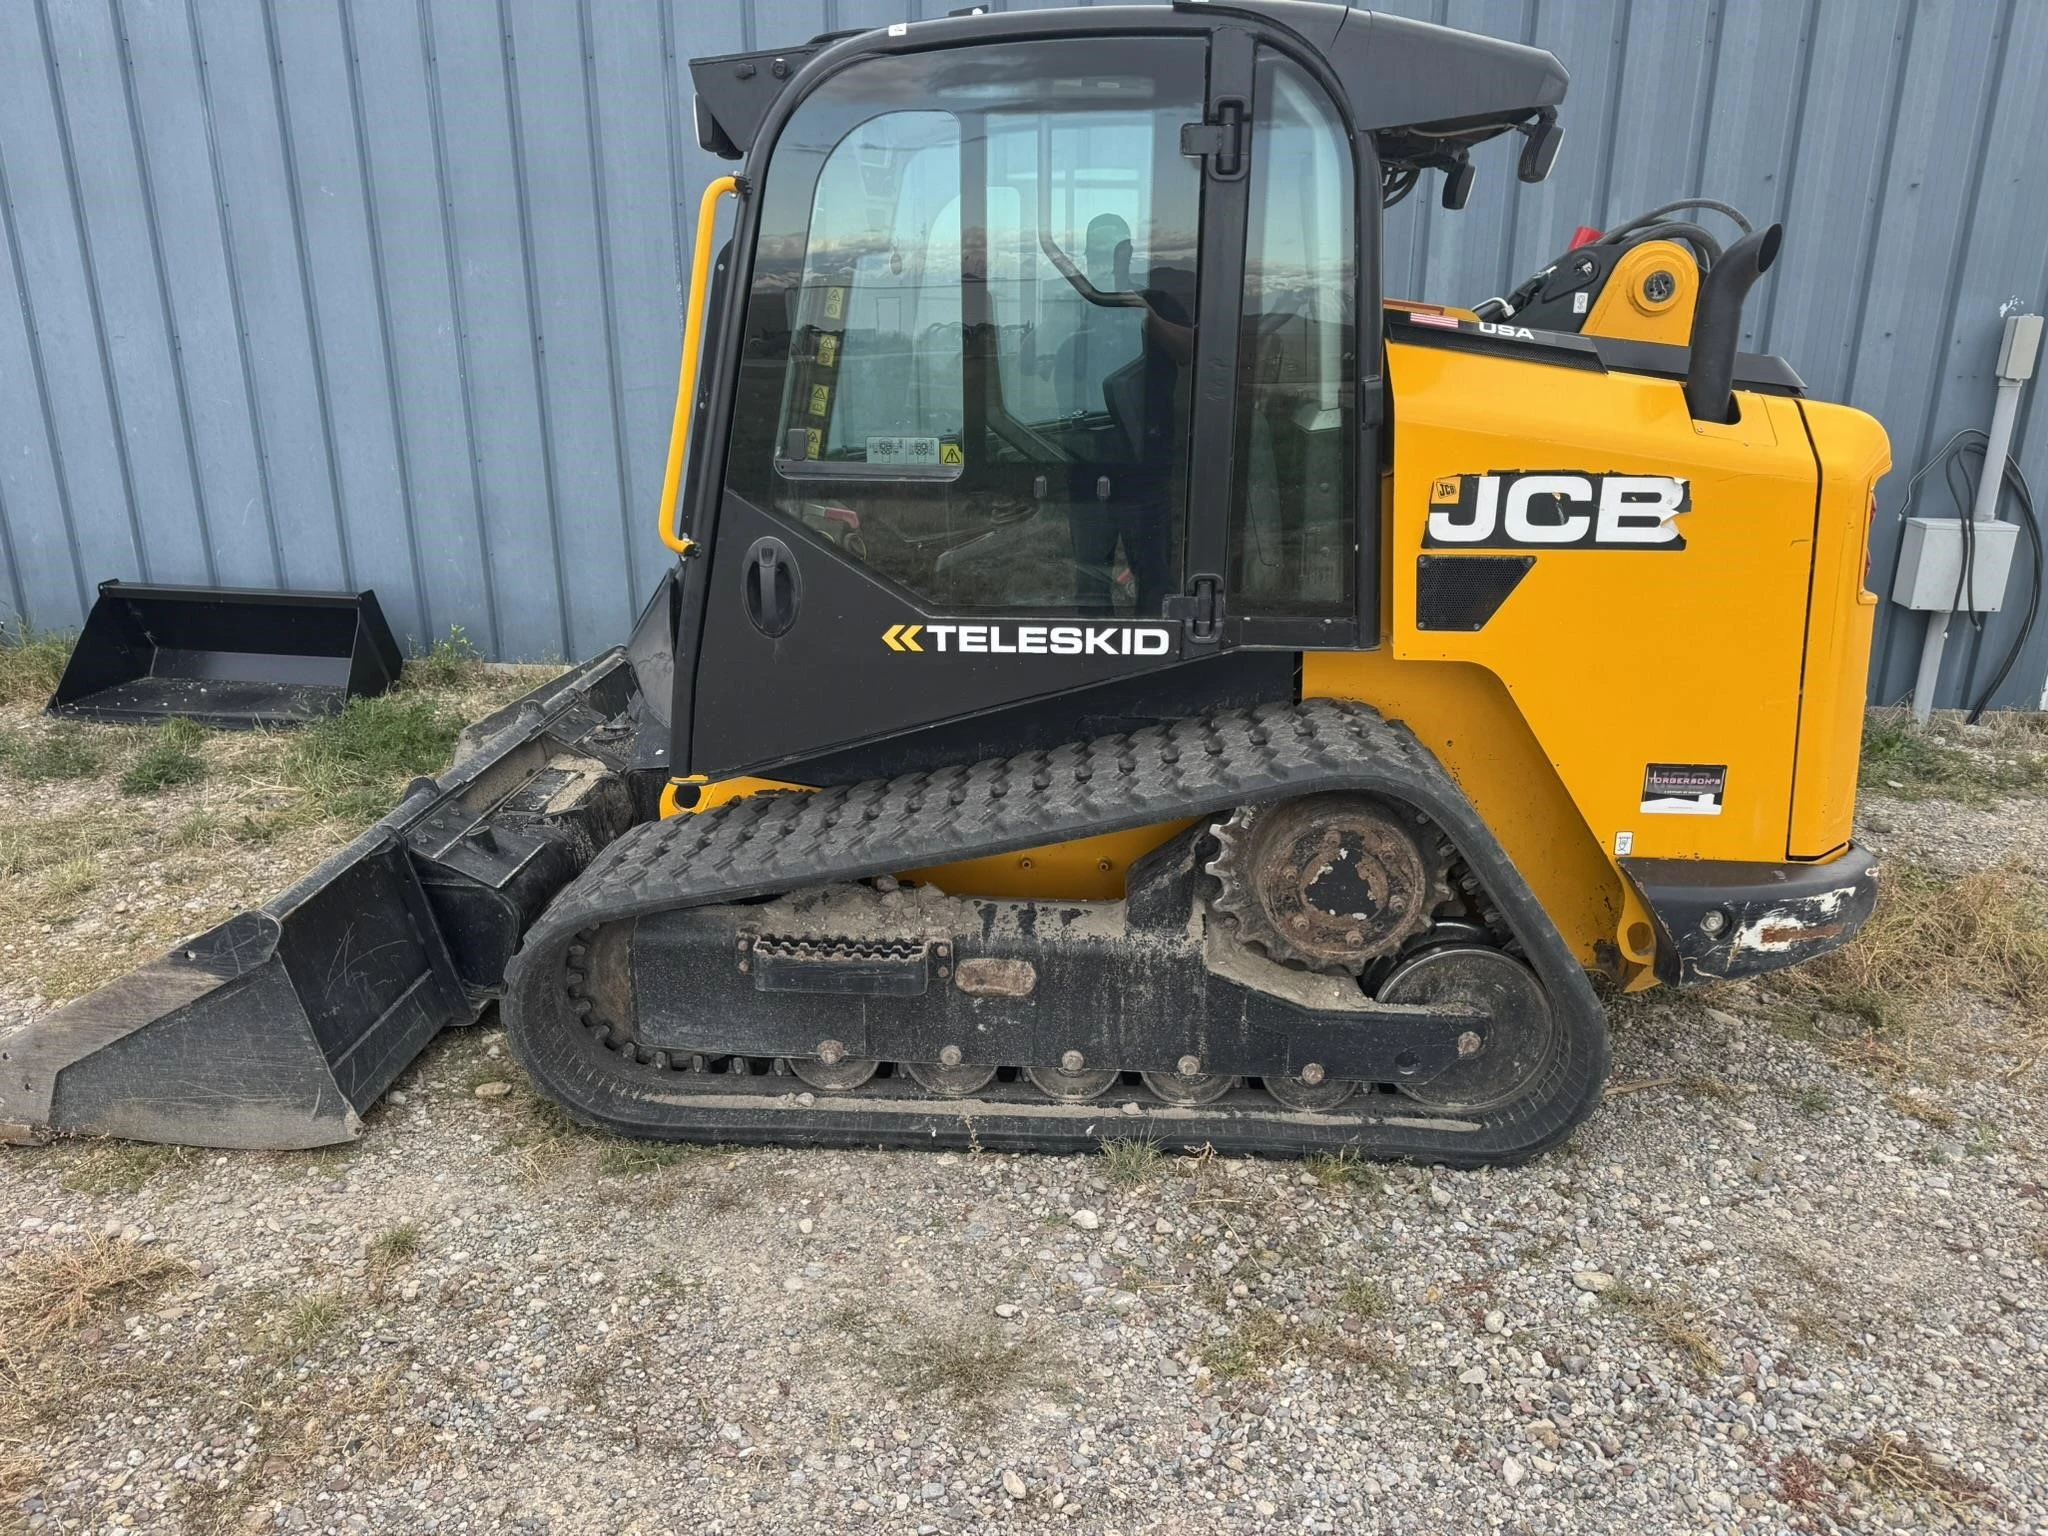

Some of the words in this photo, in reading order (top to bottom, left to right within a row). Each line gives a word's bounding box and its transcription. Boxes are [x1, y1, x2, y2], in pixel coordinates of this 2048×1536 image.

[1479, 321, 1535, 340] USA
[1439, 483, 1457, 497] JCB
[1429, 476, 1685, 543] JCB
[926, 624, 1170, 655] TELESKID
